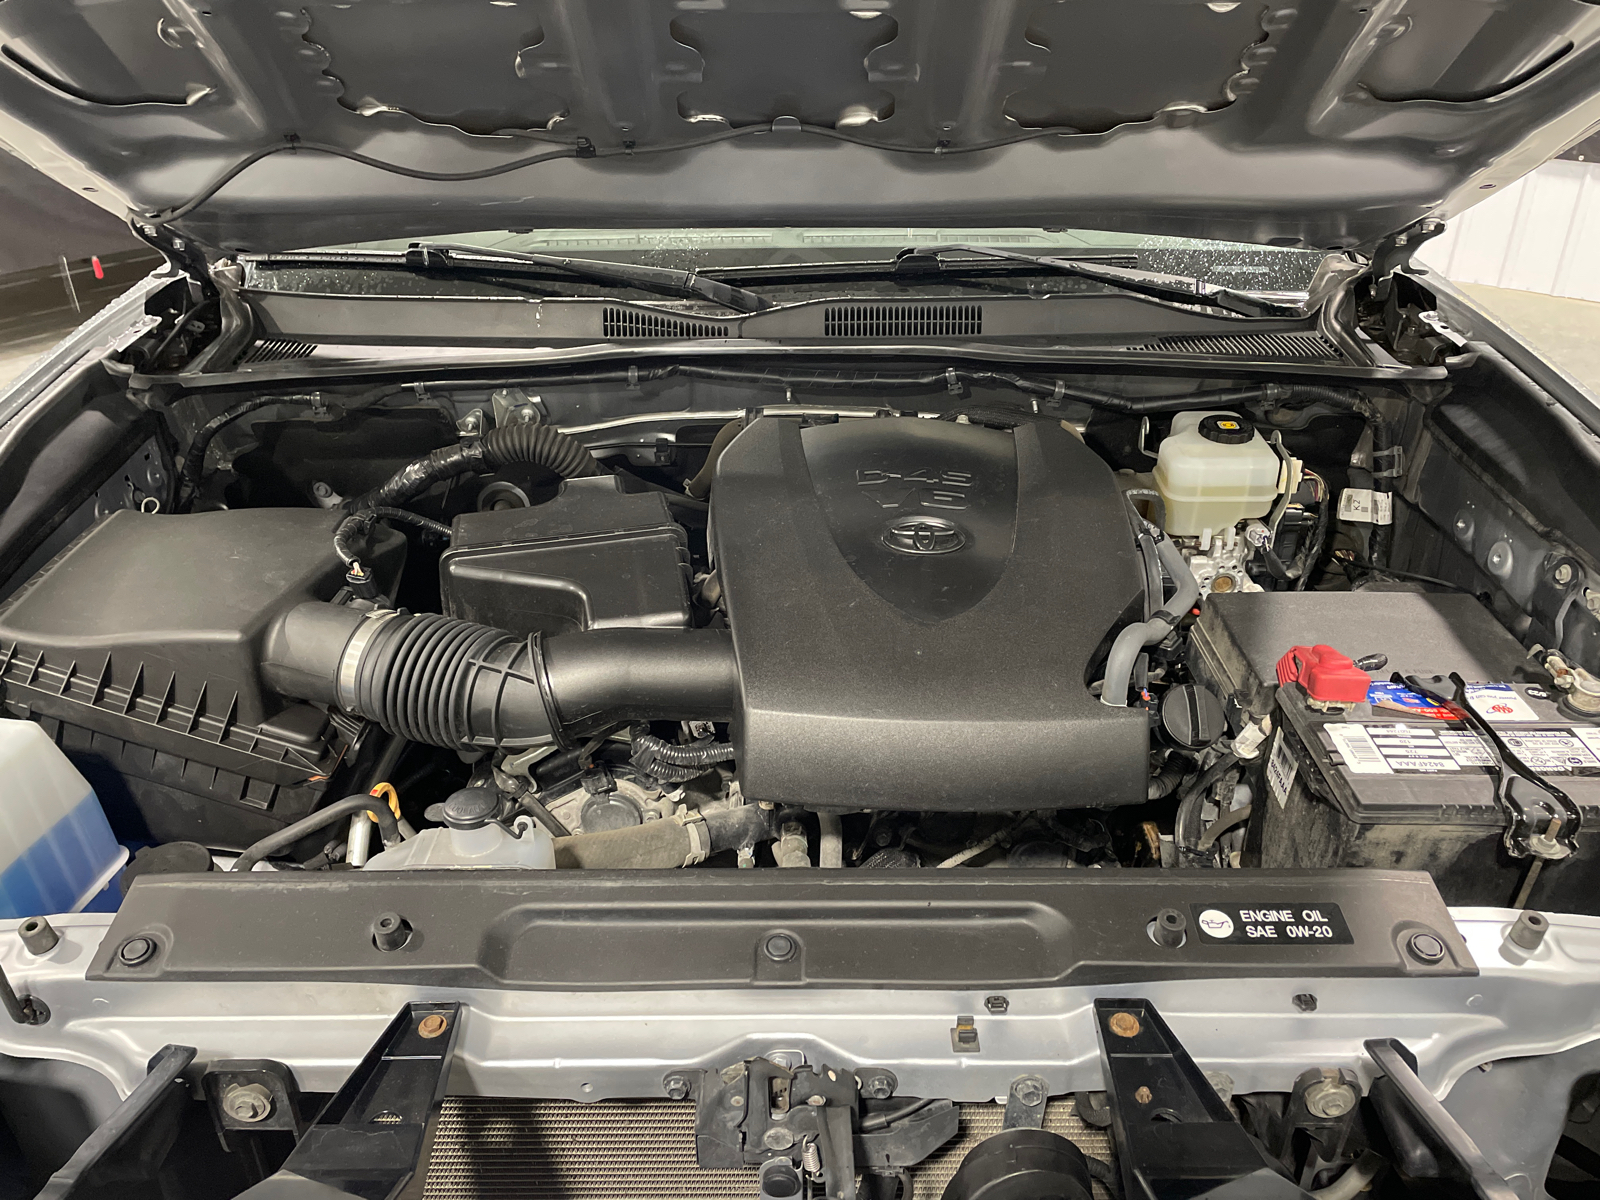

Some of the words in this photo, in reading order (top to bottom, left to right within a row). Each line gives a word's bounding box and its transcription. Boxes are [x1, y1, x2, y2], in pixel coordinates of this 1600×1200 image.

[855, 466, 972, 487] D-4S
[861, 487, 971, 510] V6
[1239, 909, 1295, 922] ENGINE
[1302, 909, 1329, 922] OIL
[1245, 925, 1278, 938] SAE
[1286, 925, 1333, 938] 0W-20
